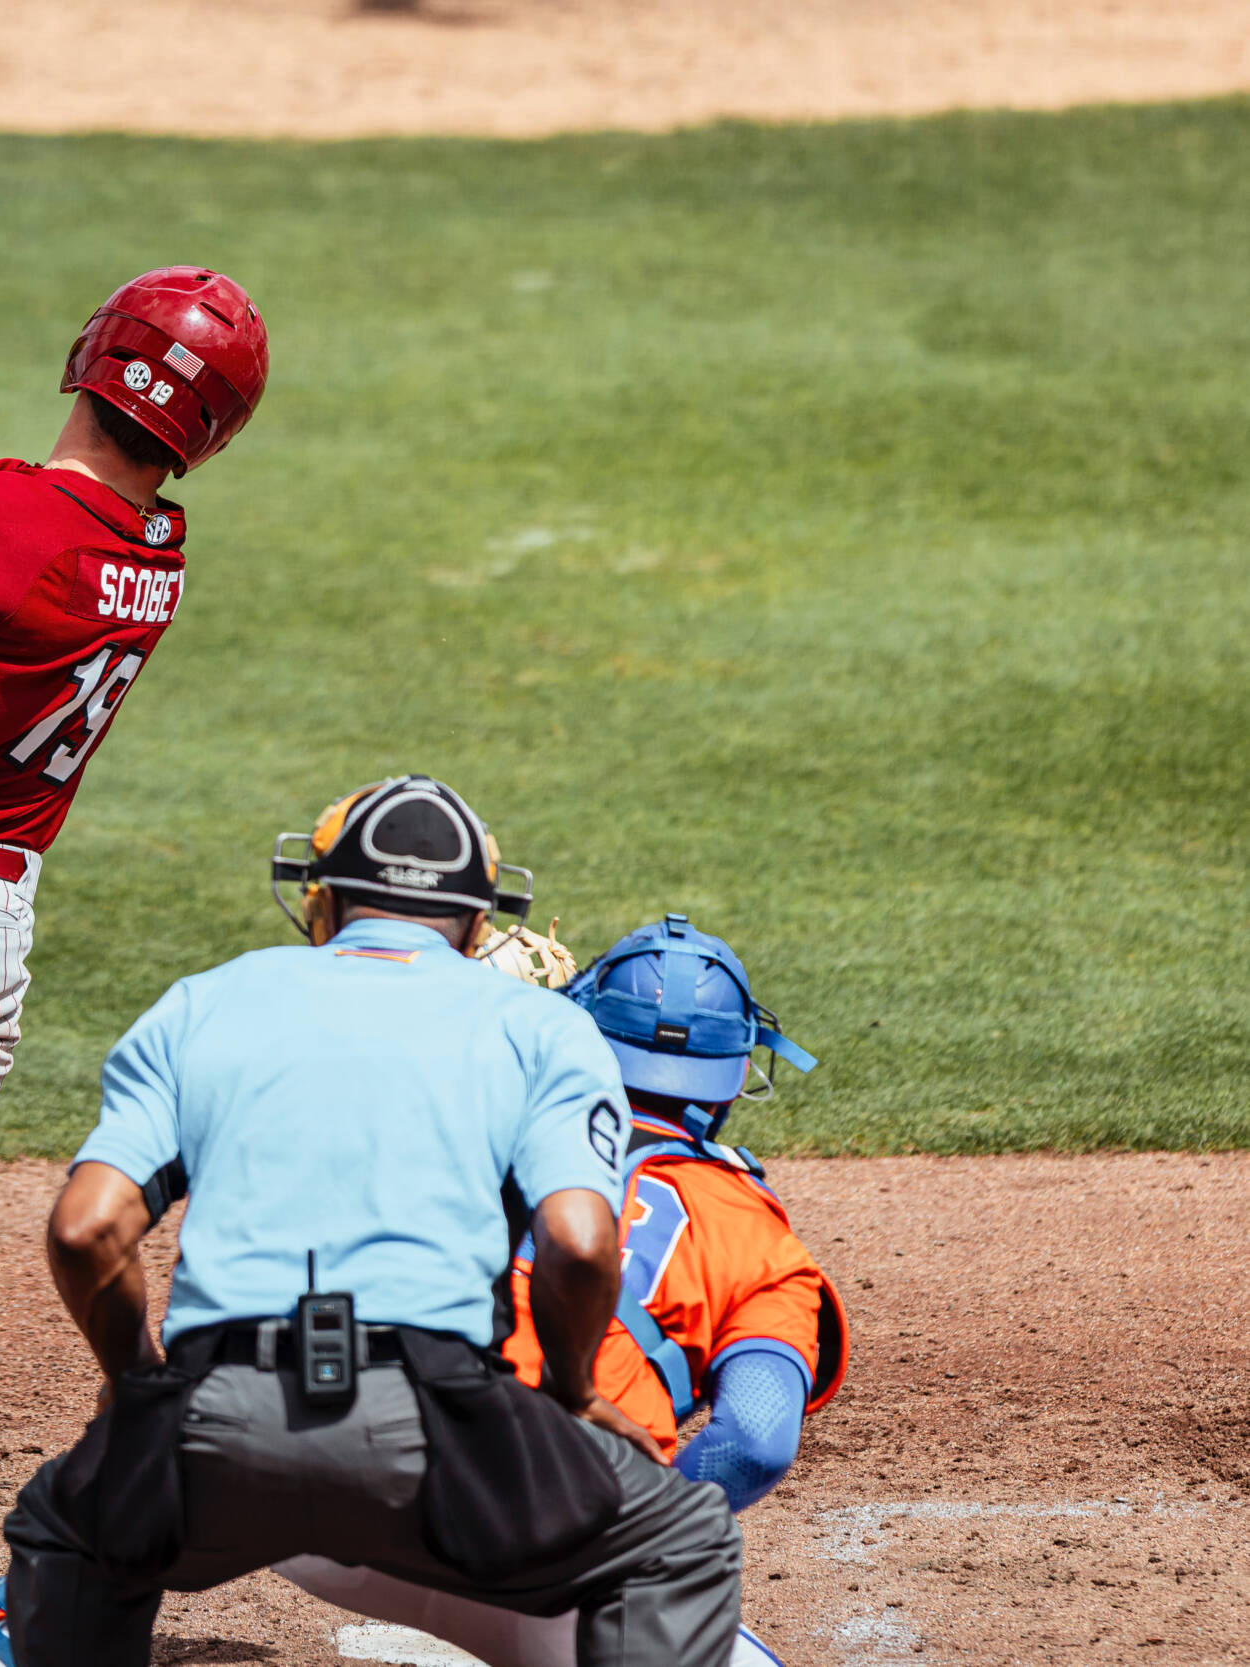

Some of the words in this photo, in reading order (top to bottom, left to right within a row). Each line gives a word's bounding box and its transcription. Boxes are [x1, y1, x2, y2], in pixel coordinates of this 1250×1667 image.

[125, 362, 150, 388] SEC
[148, 380, 174, 406] 19
[145, 517, 171, 545] SEC
[3, 642, 146, 790] 19
